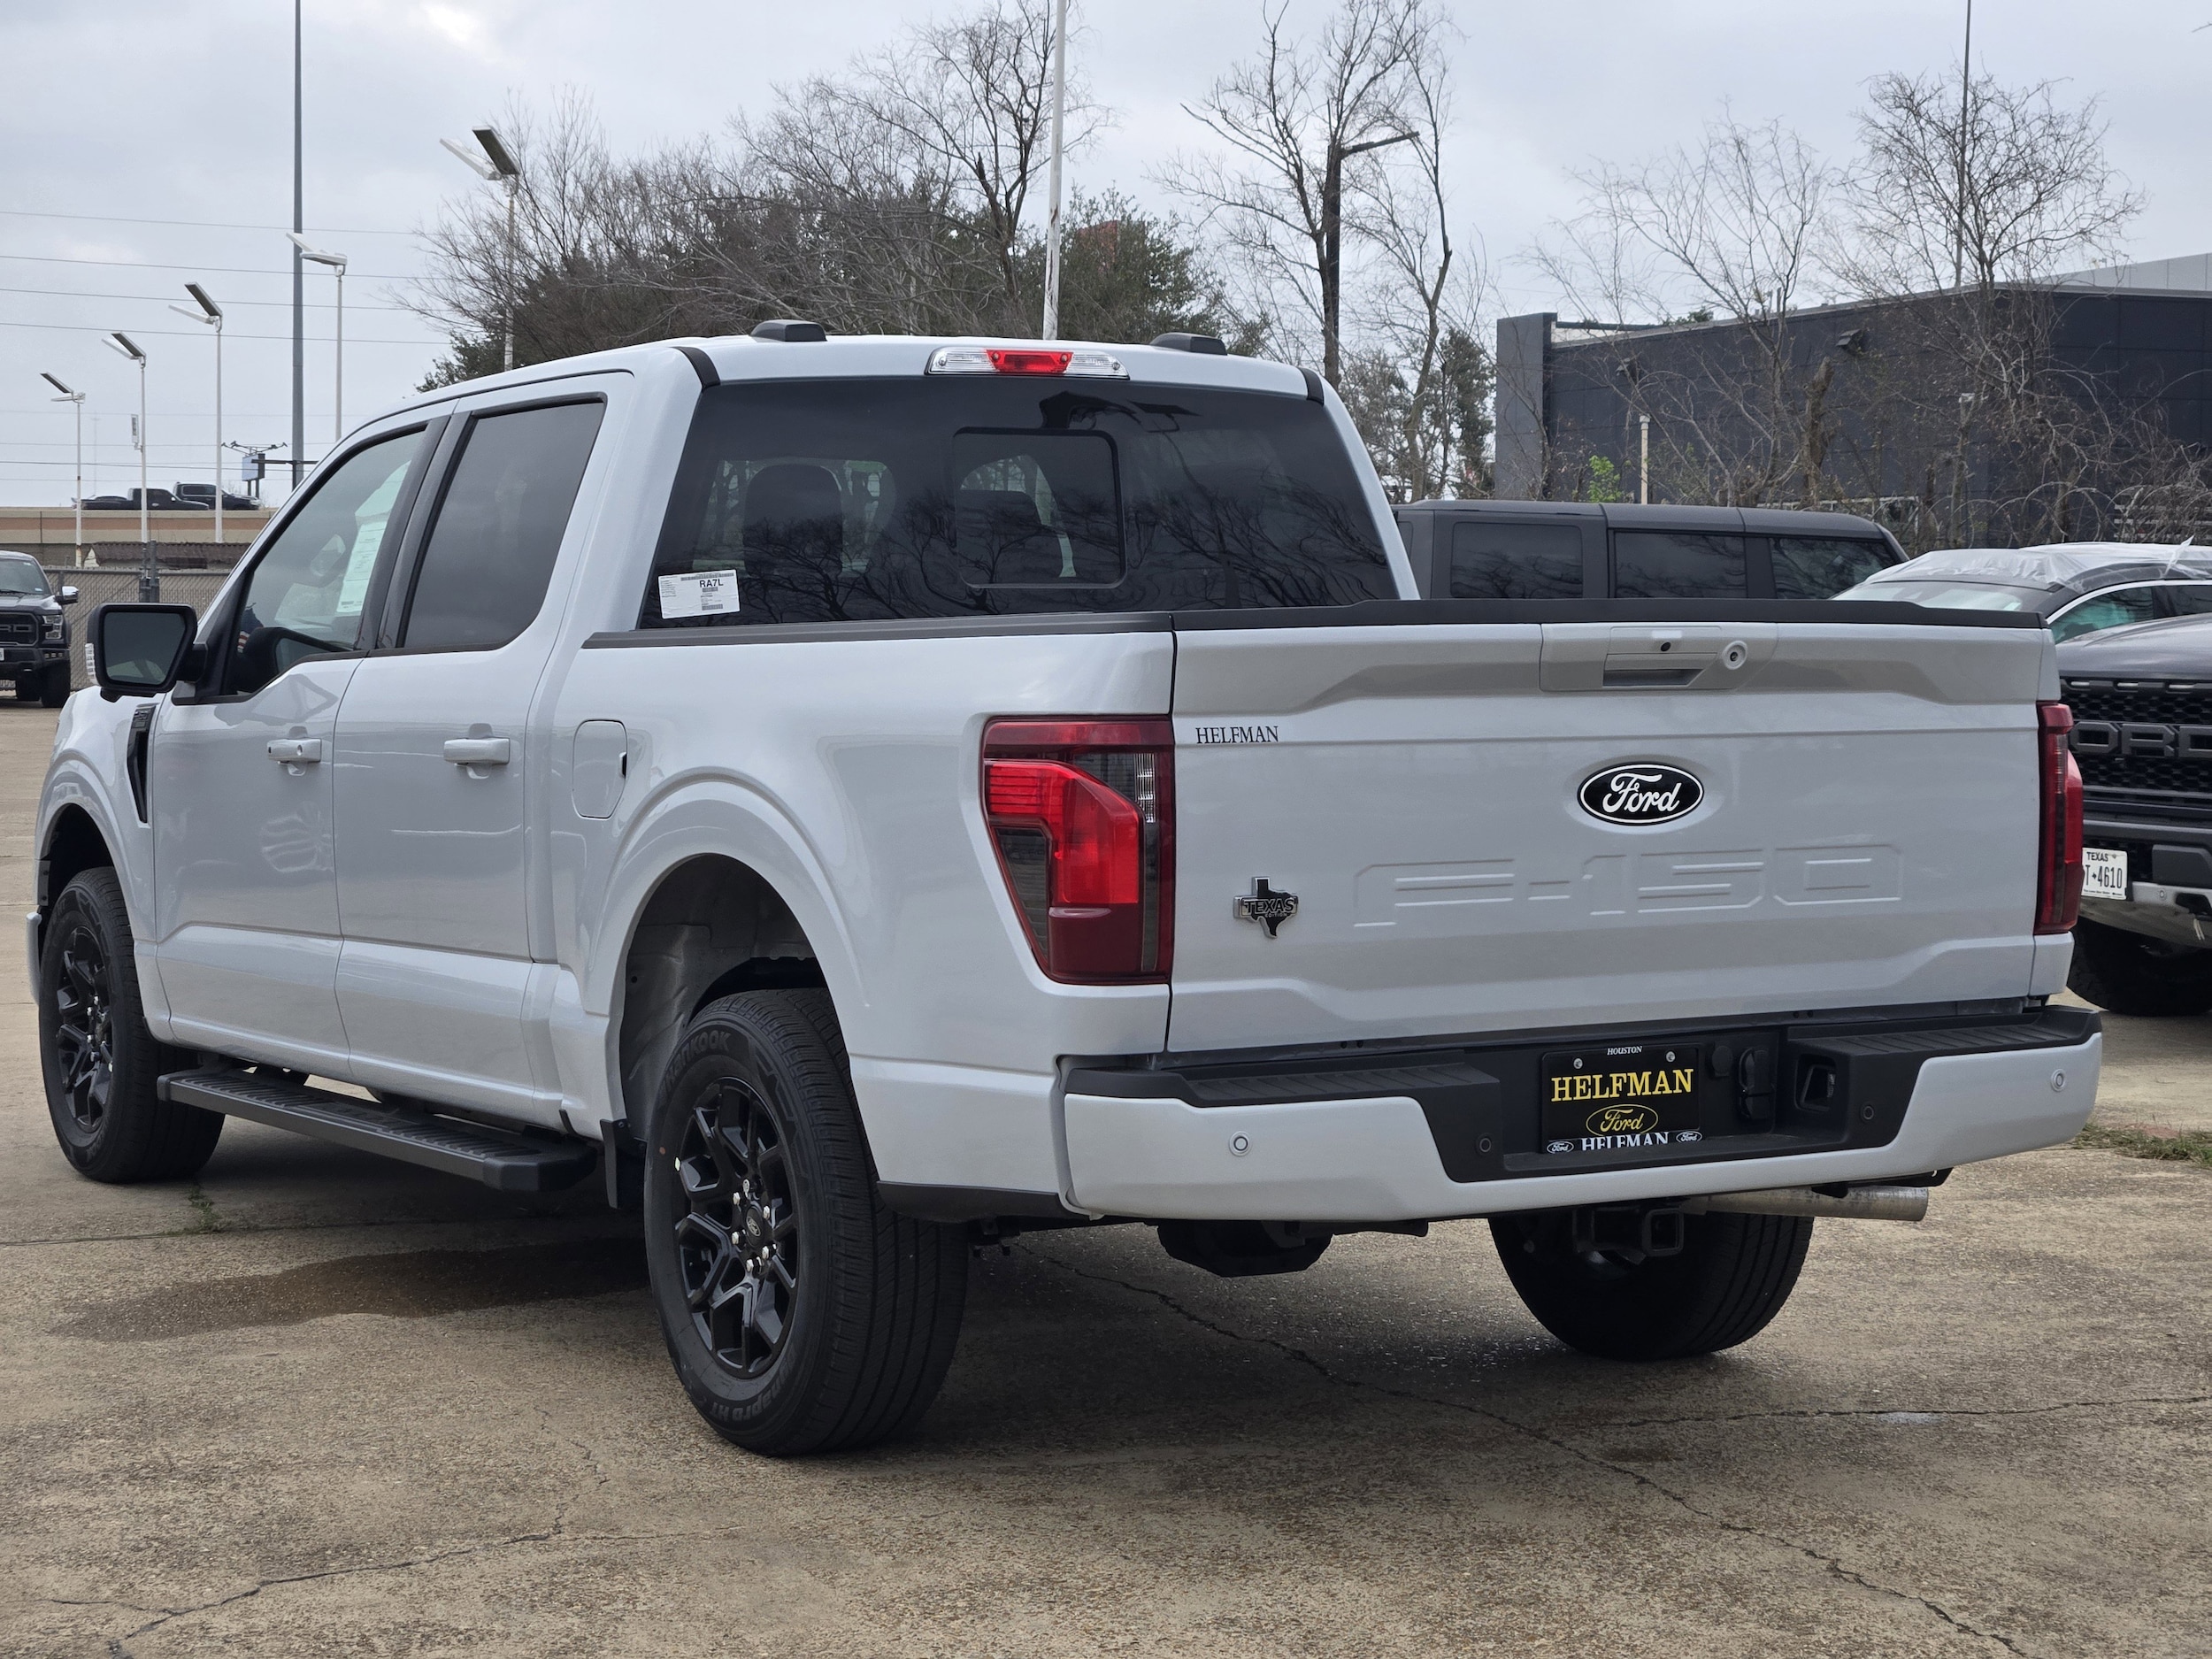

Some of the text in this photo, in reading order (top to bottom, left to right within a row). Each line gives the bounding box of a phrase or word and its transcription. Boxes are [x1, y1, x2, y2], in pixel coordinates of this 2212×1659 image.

[700, 579, 724, 588] RA7L
[0, 624, 32, 633] RD
[1195, 726, 1279, 744] HELFMAN
[2070, 720, 2212, 758] ORD
[1601, 772, 1682, 813] Ford
[2086, 851, 2109, 862] TEXAS
[1243, 897, 1295, 916] TEXAS
[1607, 1046, 1643, 1056] HOUSTON
[1551, 1068, 1694, 1102] HELFMAN
[1600, 1108, 1645, 1133] Ford
